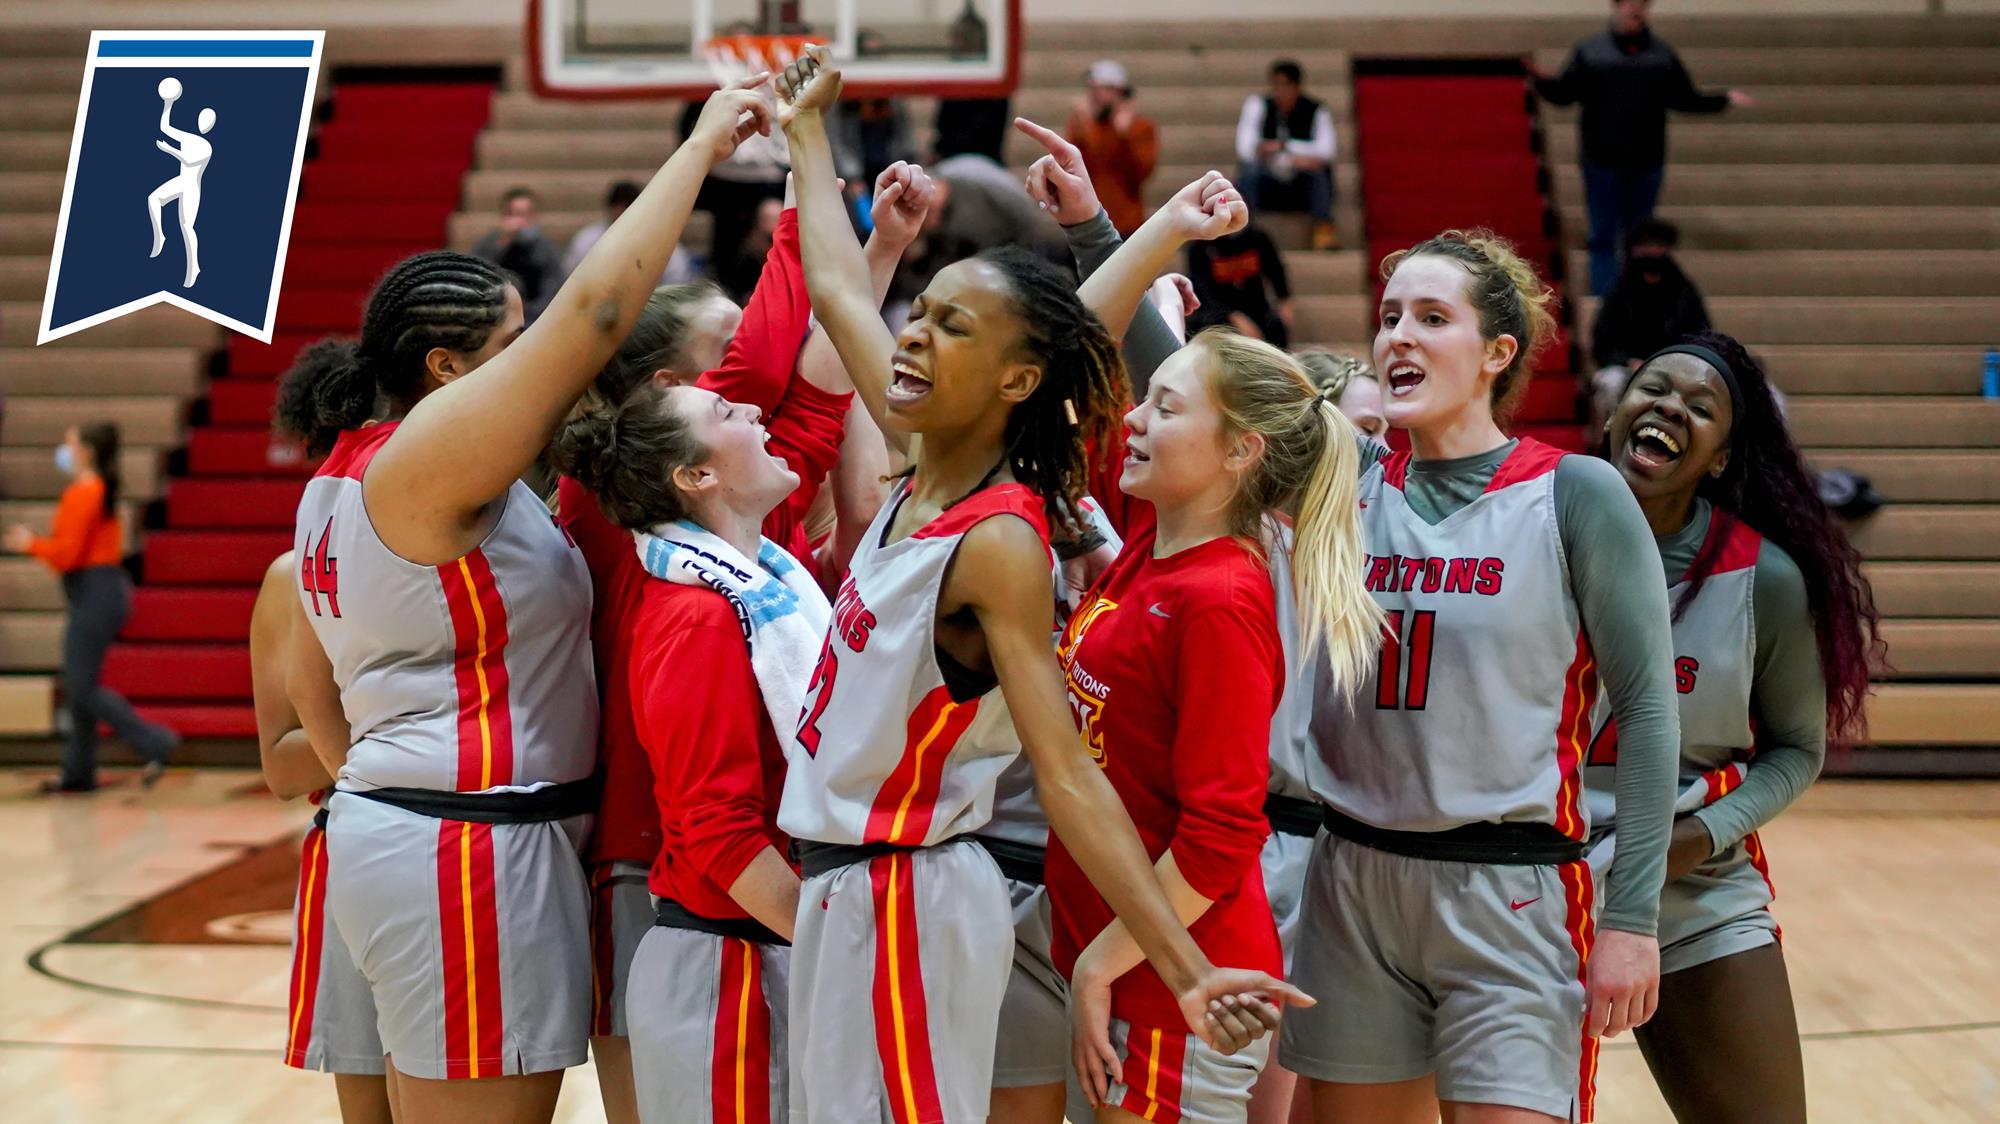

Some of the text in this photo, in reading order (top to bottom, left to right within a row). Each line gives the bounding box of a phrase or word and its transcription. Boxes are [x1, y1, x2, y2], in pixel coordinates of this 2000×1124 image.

[302, 515, 342, 618] 44
[1364, 554, 1505, 596] RITONS
[1072, 659, 1111, 699] TRITONS
[1375, 609, 1437, 711] 11
